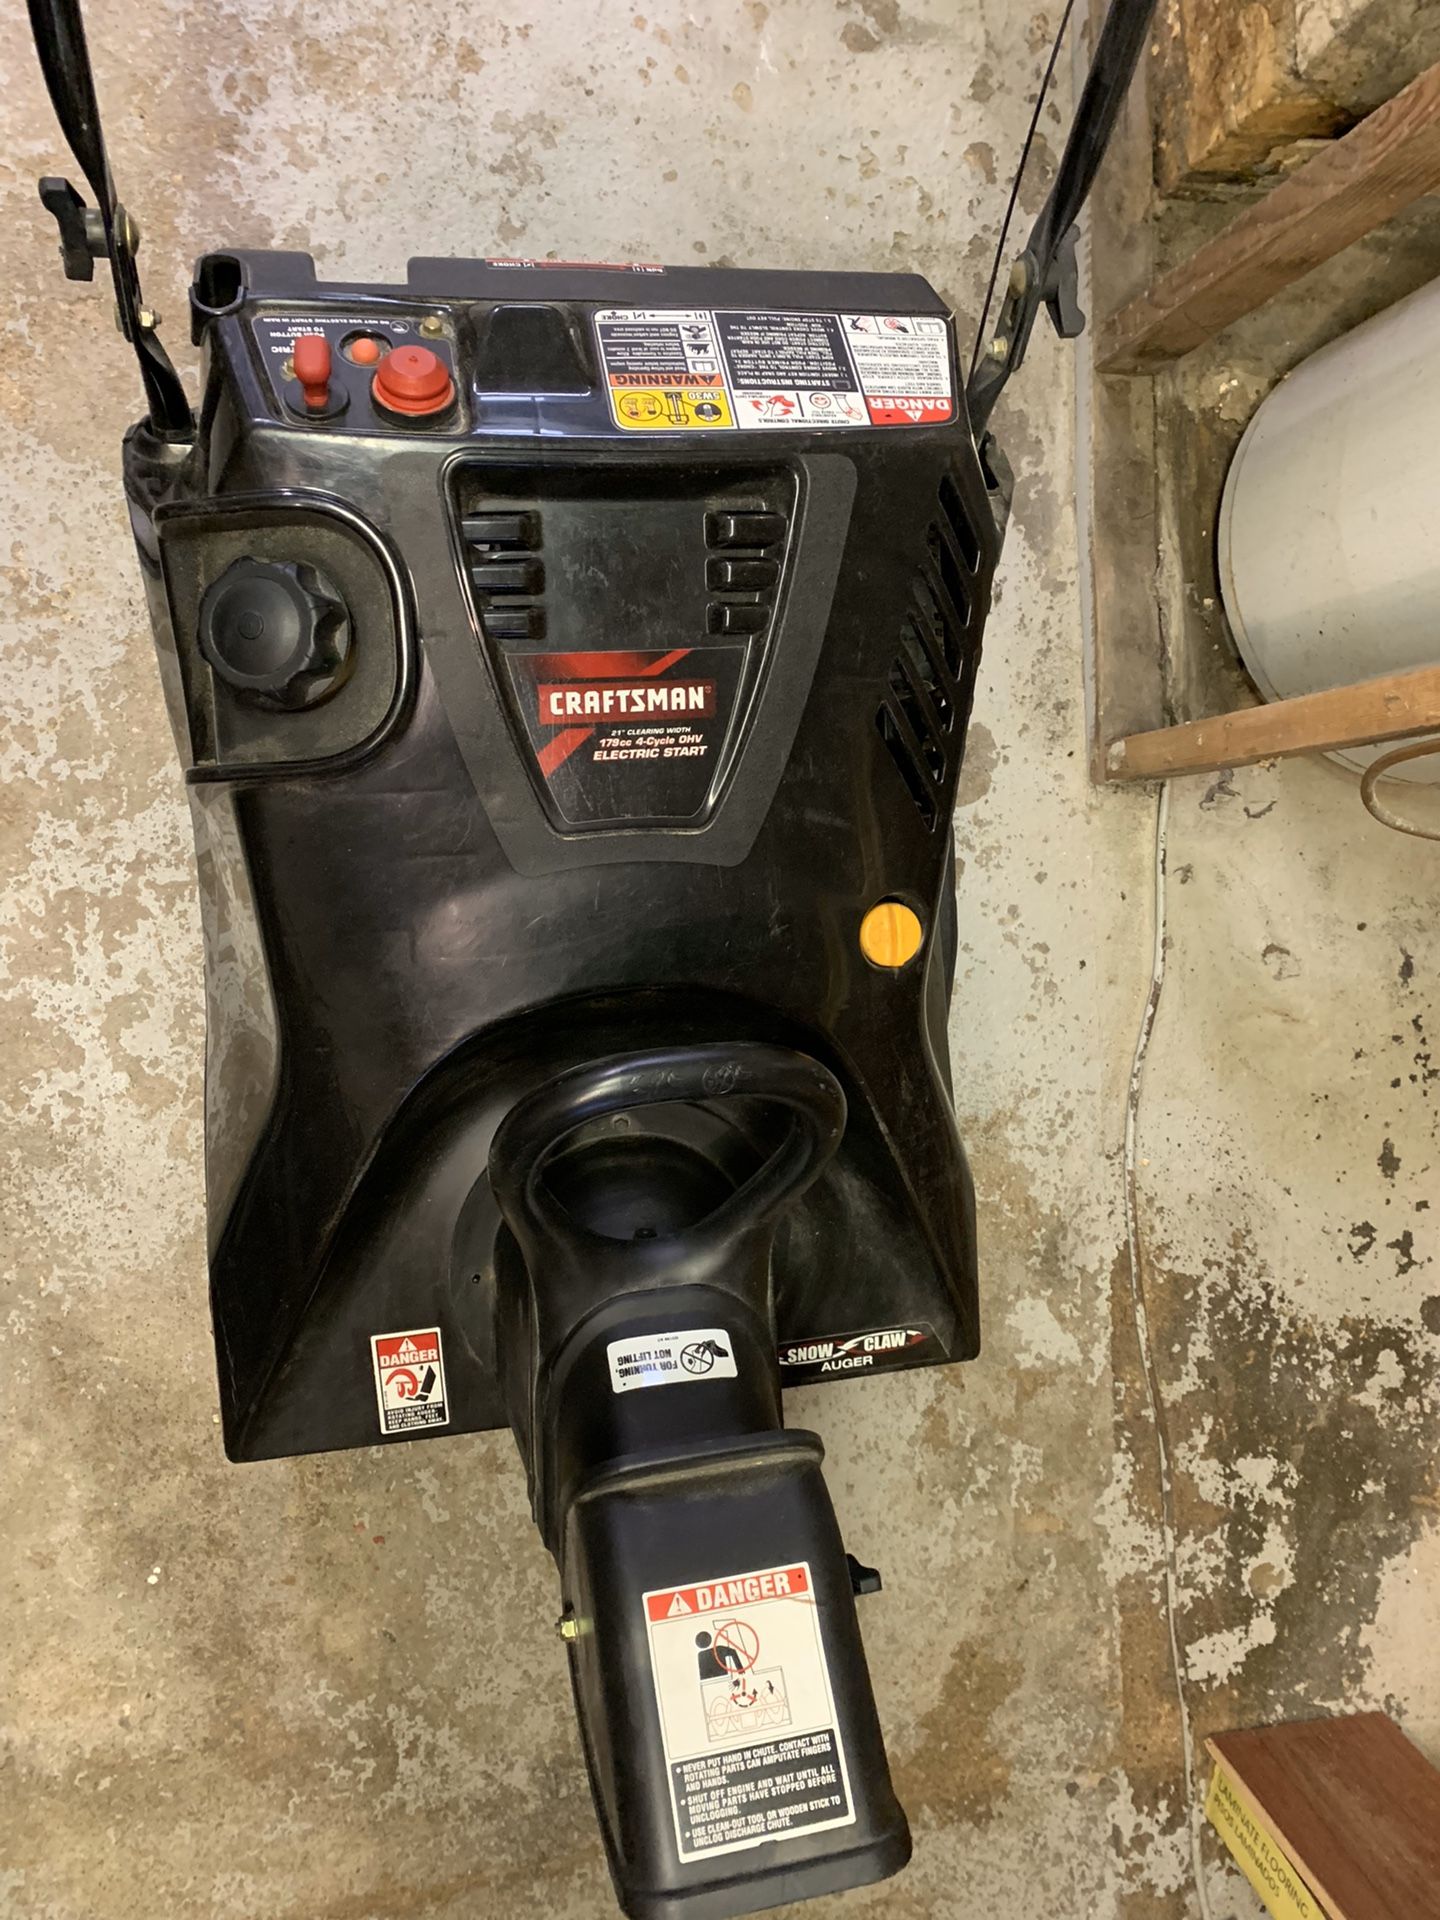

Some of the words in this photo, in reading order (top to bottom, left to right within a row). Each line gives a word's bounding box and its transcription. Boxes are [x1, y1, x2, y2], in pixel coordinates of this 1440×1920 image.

[615, 374, 698, 384] WARNING
[687, 391, 720, 399] 5W30
[868, 397, 949, 409] DANGER
[549, 686, 705, 716] CRAFTSMAN
[626, 727, 664, 735] CLEARING
[635, 734, 675, 748] 4-Cycle
[678, 733, 703, 744] OHV
[592, 746, 660, 761] ELECTRIC
[663, 745, 708, 757] START
[653, 1348, 671, 1359] NOT
[786, 1342, 835, 1363] SNOW
[862, 1331, 907, 1352] CLAW
[379, 1348, 438, 1367] DANGER
[616, 1351, 651, 1365] LIFTING
[659, 1359, 677, 1371] FOR
[820, 1354, 873, 1372] AUGER
[695, 1573, 791, 1612] DANGER
[681, 1760, 706, 1773] NEVER
[706, 1756, 722, 1767] PUT
[722, 1751, 742, 1764] HAND
[743, 1750, 751, 1759] IN
[752, 1744, 778, 1757] CHUTE.
[778, 1737, 810, 1751] CONTACT
[810, 1732, 829, 1744] WITH
[683, 1767, 720, 1782] ROTATING
[720, 1761, 745, 1773] PARTS
[745, 1757, 761, 1768] CAN
[761, 1749, 800, 1764] AMPUTATE
[800, 1742, 831, 1756] FINGERS
[684, 1781, 700, 1792] AND
[701, 1774, 729, 1788] HANDS.
[686, 1792, 708, 1805] SHUT
[710, 1788, 725, 1799] OFF
[726, 1782, 755, 1795] ENGINE
[756, 1778, 773, 1789] AND
[774, 1773, 795, 1785] WAIT
[796, 1768, 818, 1780] UNTIL
[820, 1764, 835, 1774] ALL
[687, 1800, 720, 1814] MOVING
[721, 1794, 747, 1806] PARTS
[748, 1788, 769, 1800] HAVE
[770, 1780, 806, 1795] STOPPED
[806, 1773, 836, 1787] BEFORE
[689, 1805, 741, 1824] UNCLOGGING.
[691, 1826, 706, 1837] USE
[706, 1817, 746, 1833] CLEAN-OUT
[746, 1812, 765, 1824] TOOL
[766, 1810, 777, 1820] OR
[777, 1802, 808, 1817] WOODEN
[808, 1797, 830, 1810] STICK
[831, 1795, 841, 1804] TO
[692, 1832, 723, 1847] UNCLOG
[723, 1822, 766, 1839] DISCHARGE
[766, 1816, 793, 1830] CHUTE.
[1213, 1793, 1235, 1826] PISOS
[1234, 1826, 1280, 1897] LAMINADOS
[1218, 1779, 1260, 1844] LAMINATE
[1261, 1843, 1309, 1919] FLOORING
